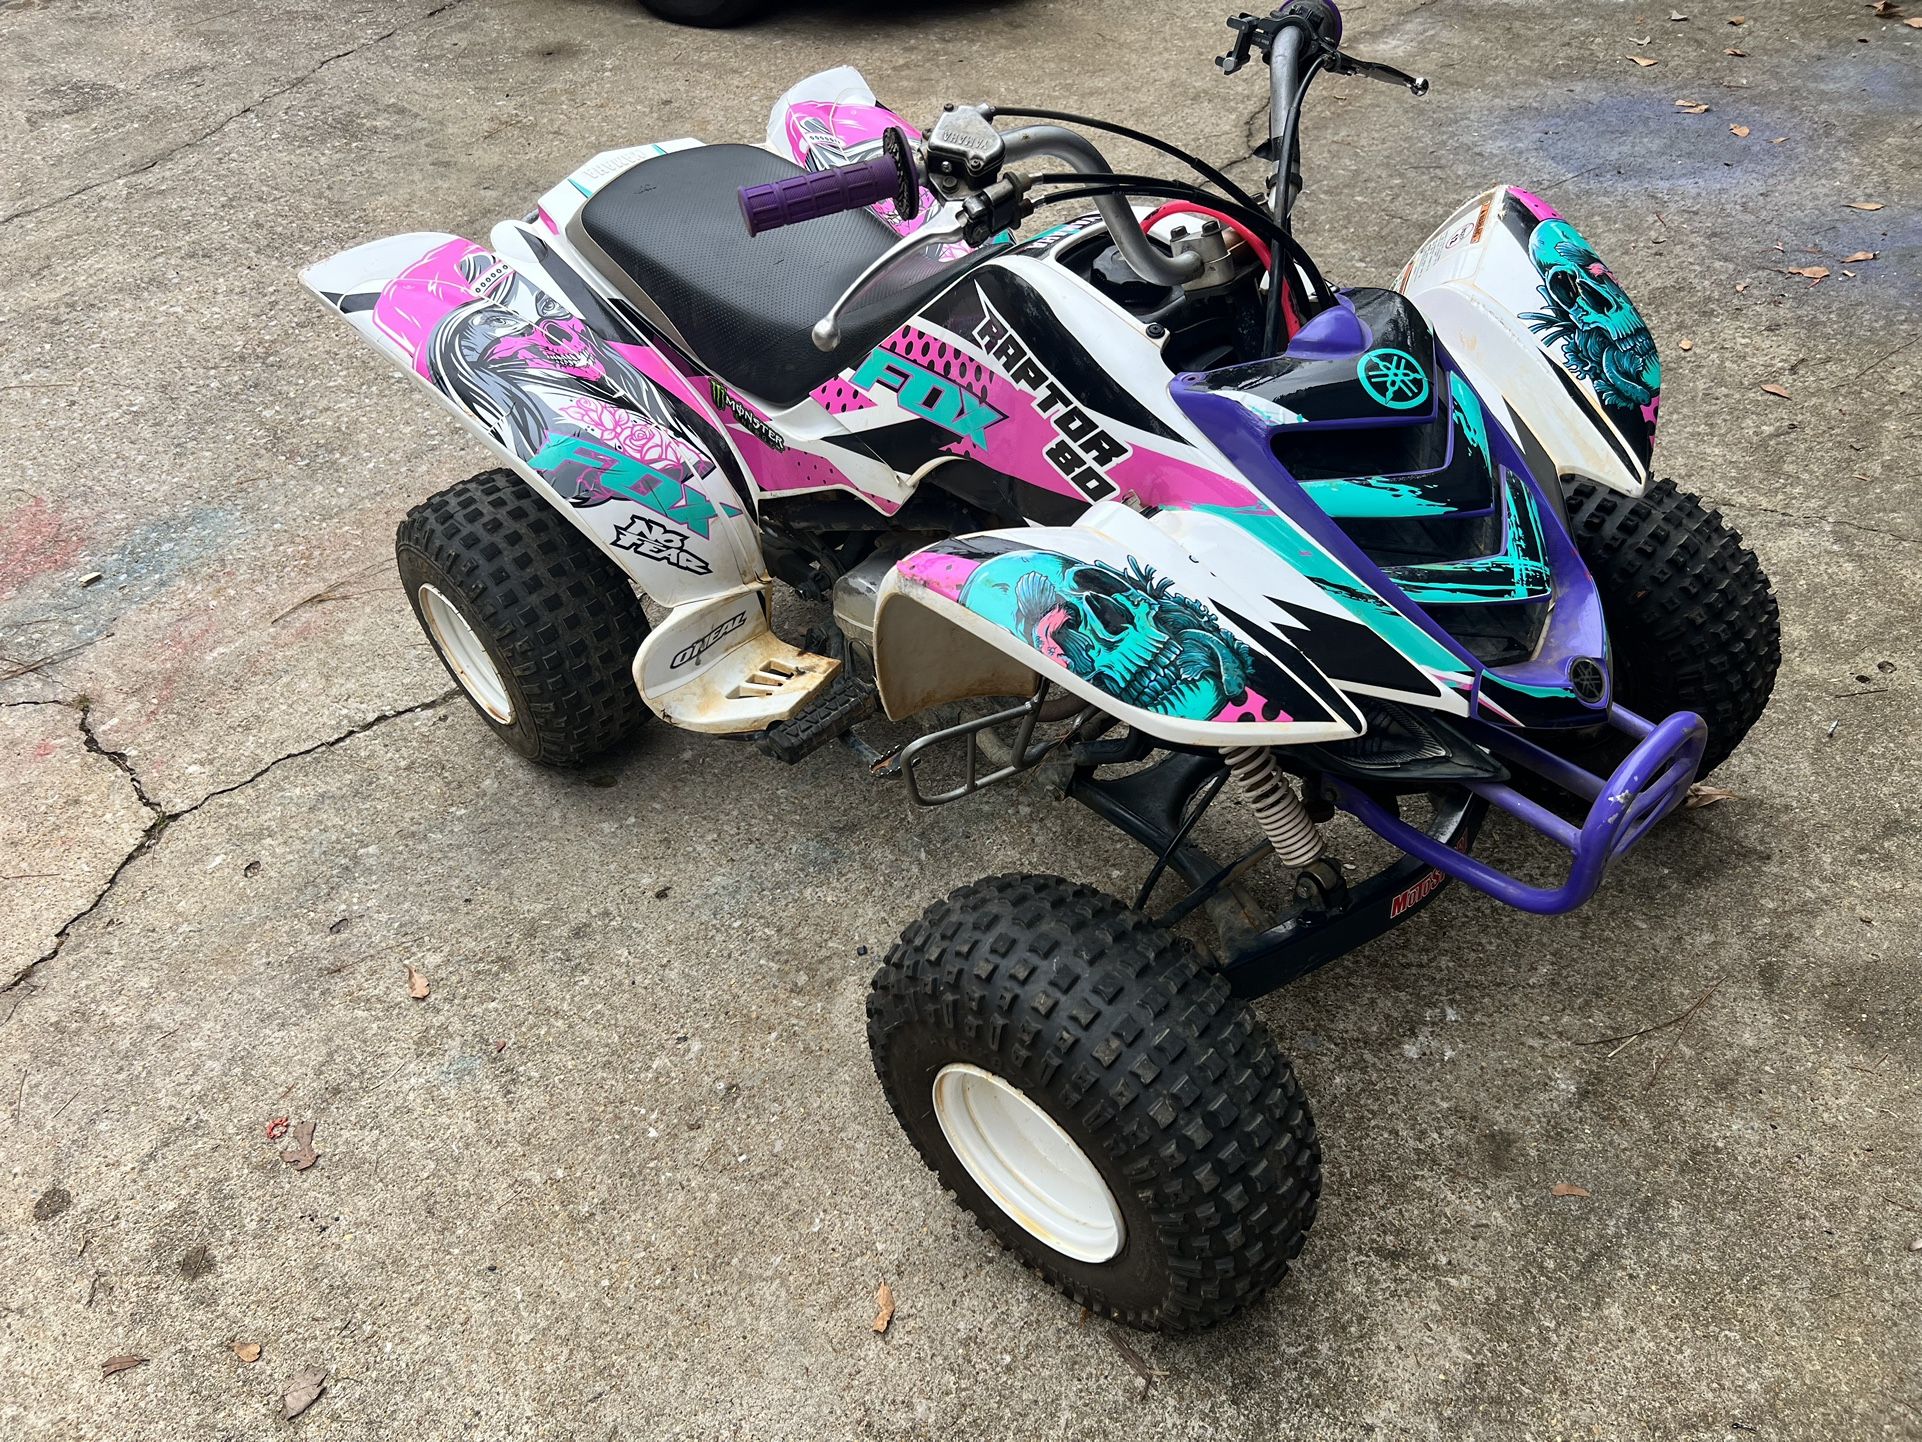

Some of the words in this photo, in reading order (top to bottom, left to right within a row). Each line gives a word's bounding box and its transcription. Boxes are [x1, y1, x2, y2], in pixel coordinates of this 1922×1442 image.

[943, 128, 989, 151] YAMAHA
[849, 346, 1010, 451] FOX
[972, 284, 1131, 469] RAPTOR
[725, 395, 785, 450] MONSTER
[527, 430, 744, 540] FOX
[1043, 437, 1119, 504] 80
[610, 526, 713, 576] FEAR
[629, 514, 690, 549] NO
